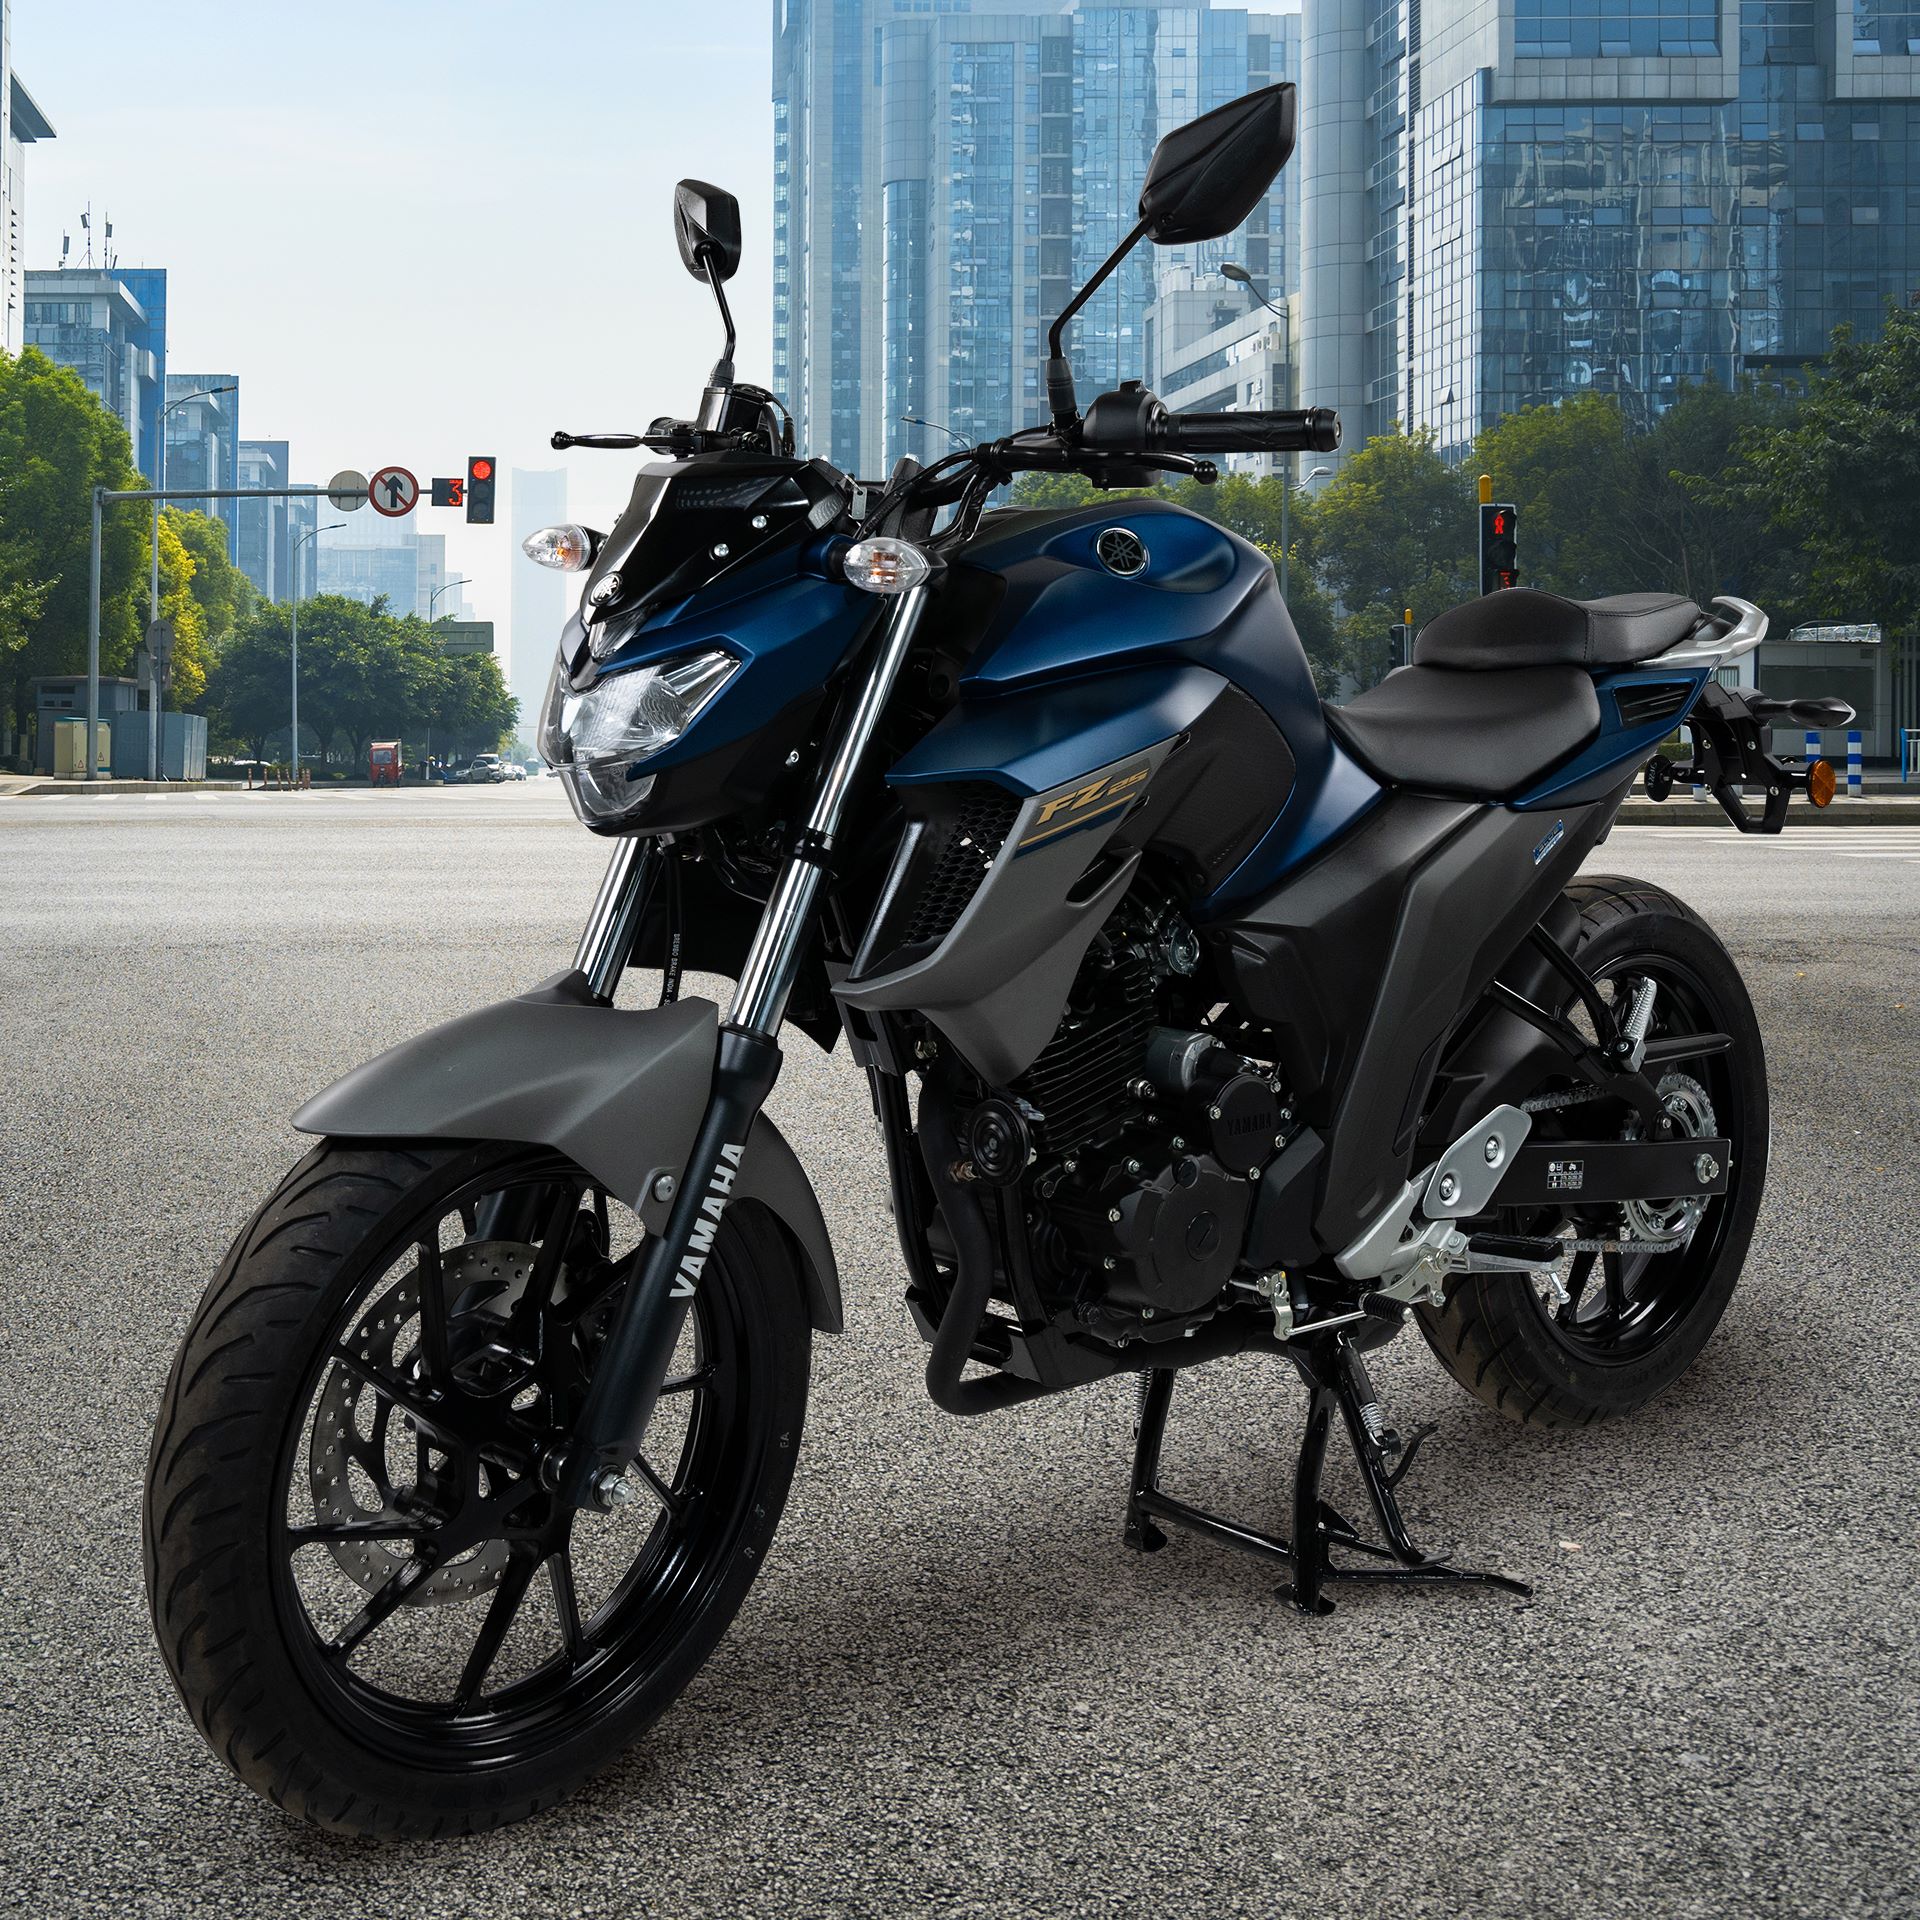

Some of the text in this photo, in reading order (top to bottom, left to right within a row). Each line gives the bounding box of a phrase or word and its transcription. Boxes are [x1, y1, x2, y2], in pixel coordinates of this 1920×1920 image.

[448, 479, 463, 506] 3
[669, 957, 678, 977] BRAKE
[666, 978, 675, 993] INDIA
[1227, 1112, 1271, 1137] YAMAHA
[669, 1143, 746, 1298] YAMAHA
